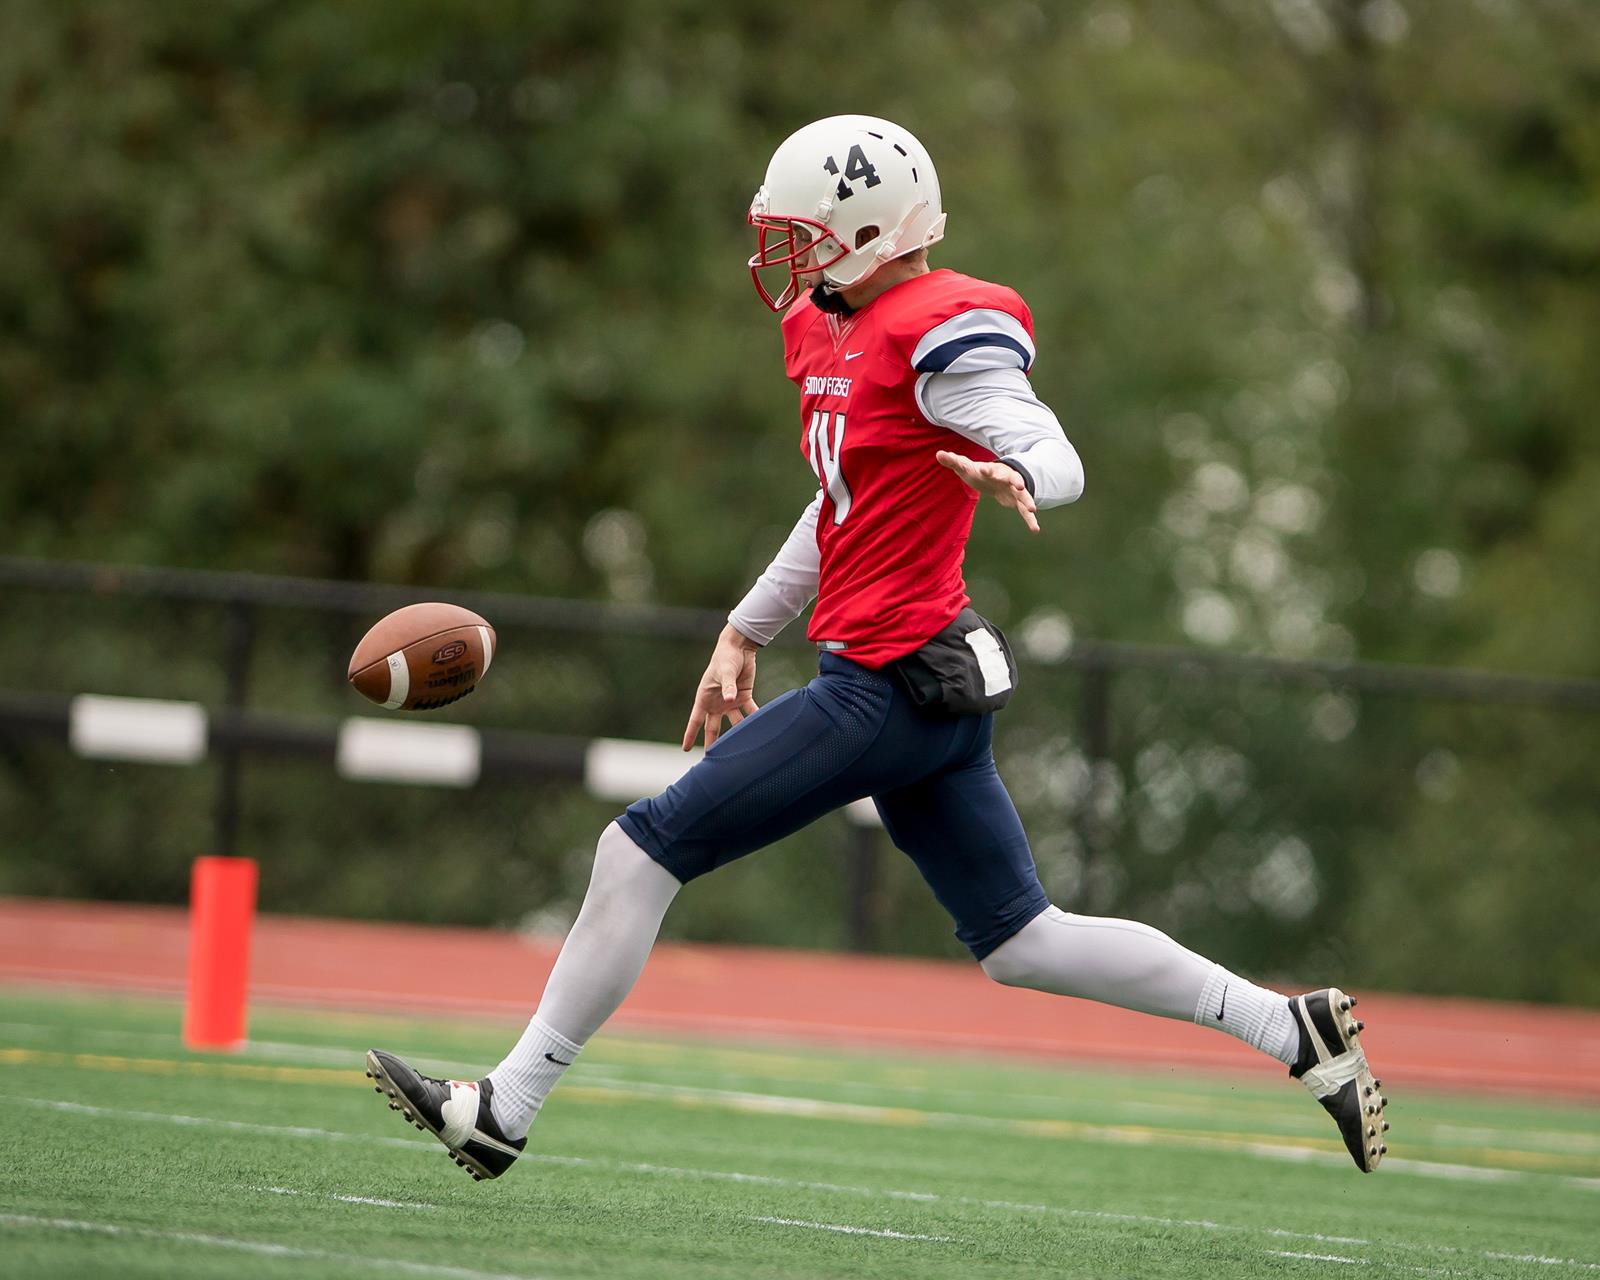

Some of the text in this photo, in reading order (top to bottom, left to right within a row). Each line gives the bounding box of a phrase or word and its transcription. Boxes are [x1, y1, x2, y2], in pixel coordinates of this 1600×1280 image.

[823, 144, 881, 201] 14
[808, 409, 852, 526] 14
[433, 643, 466, 664] GST
[427, 667, 476, 688] Wilson
